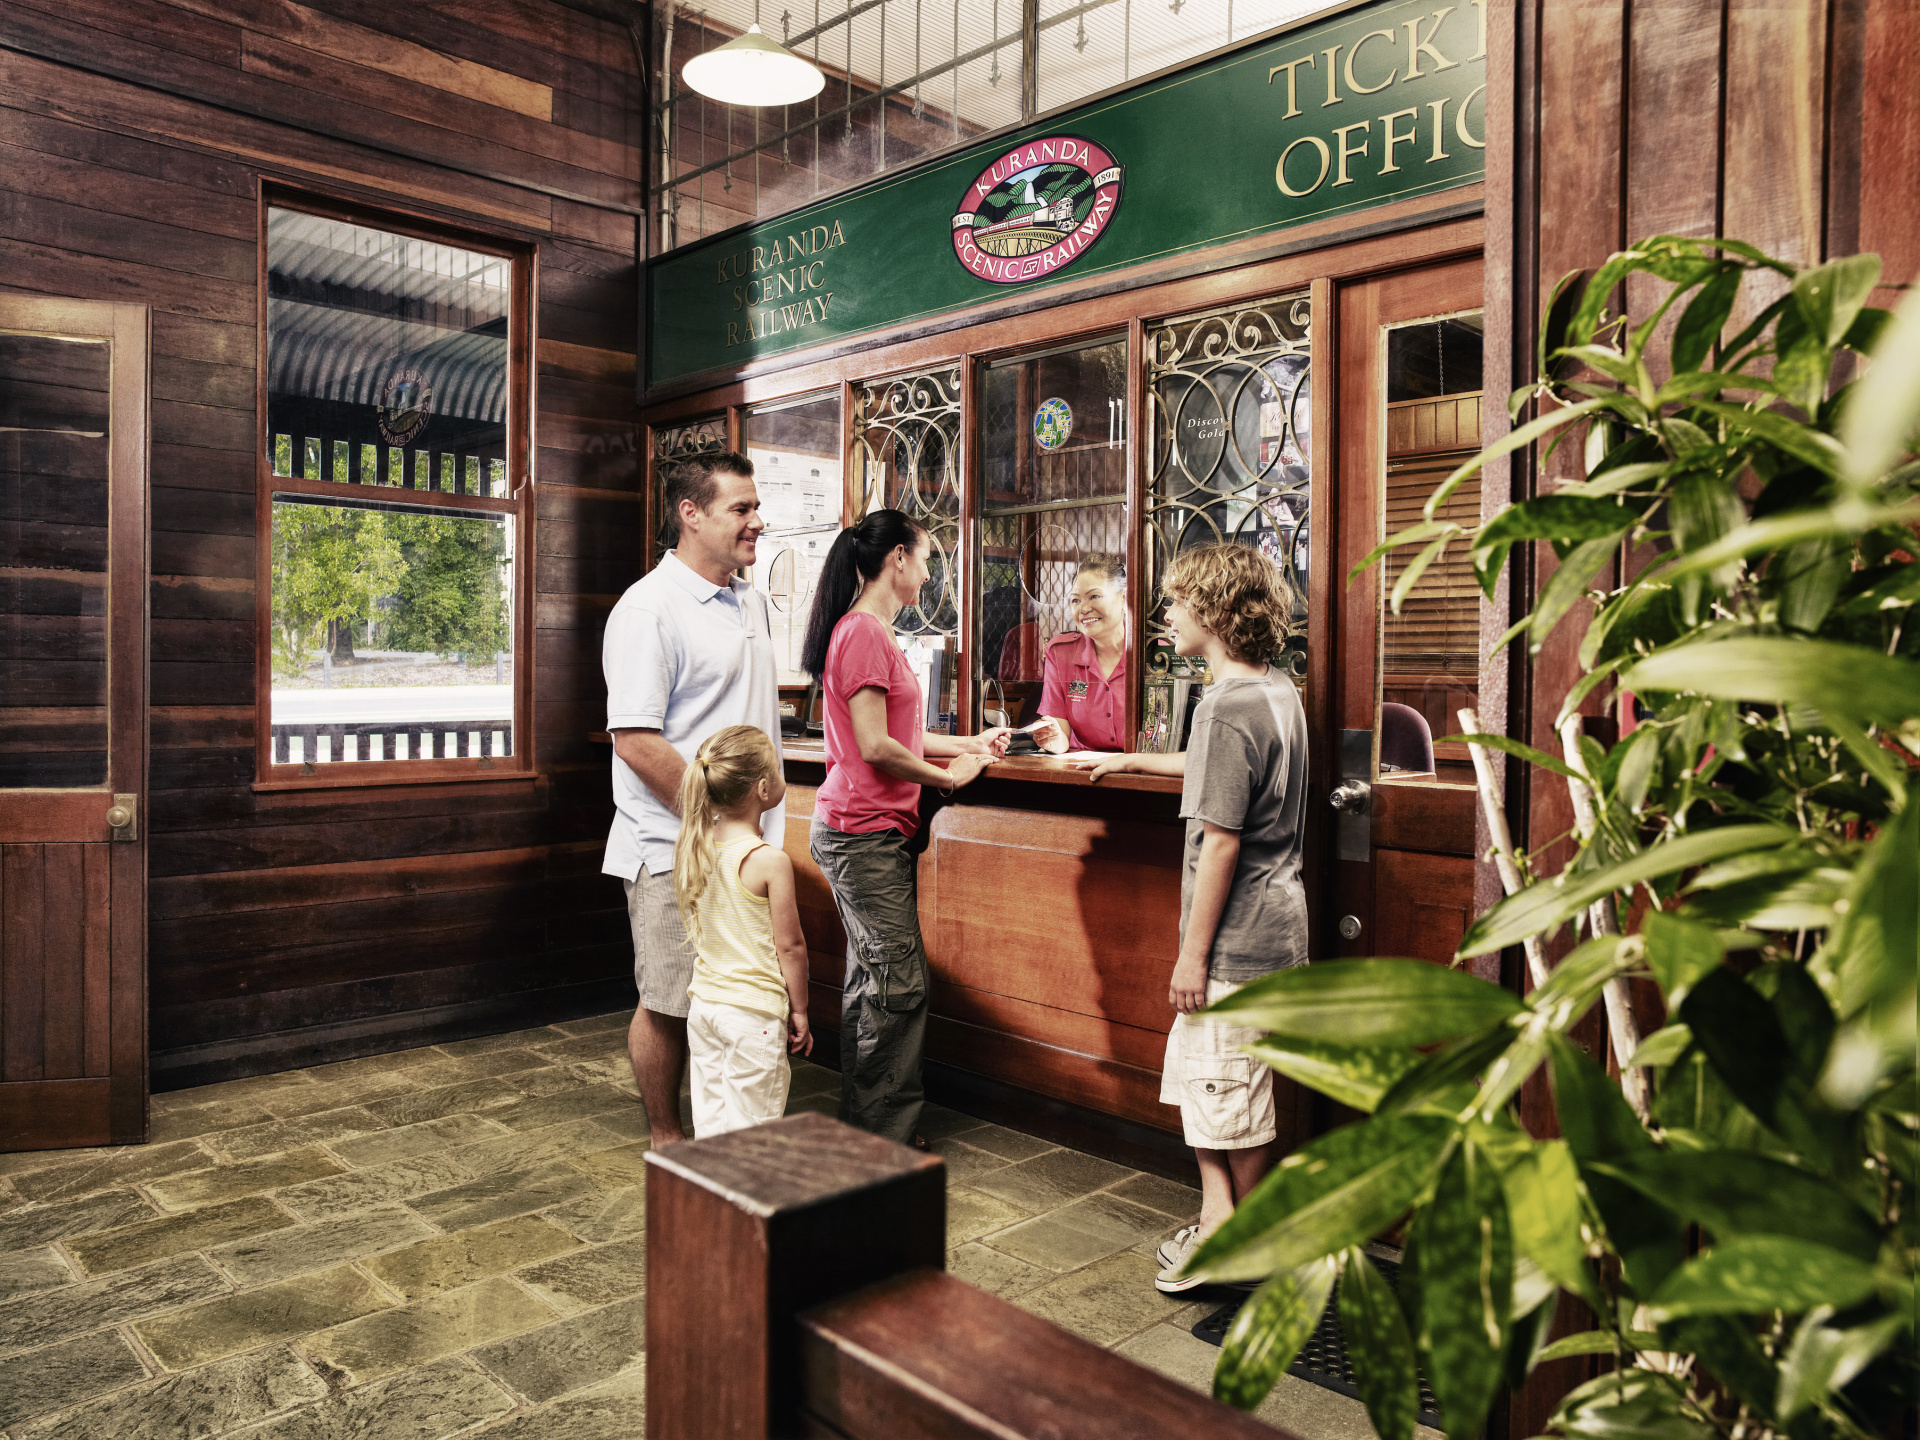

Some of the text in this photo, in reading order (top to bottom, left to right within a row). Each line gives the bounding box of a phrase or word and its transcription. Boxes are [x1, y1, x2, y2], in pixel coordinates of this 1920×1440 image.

[975, 140, 1089, 197] KURANDA
[1097, 171, 1115, 183] 1891
[717, 219, 847, 285] KURANDA
[957, 232, 1019, 279] SCENIC
[1043, 190, 1112, 271] RAILWAY
[733, 260, 826, 311] SCENIC
[726, 292, 833, 347] RAILWAY
